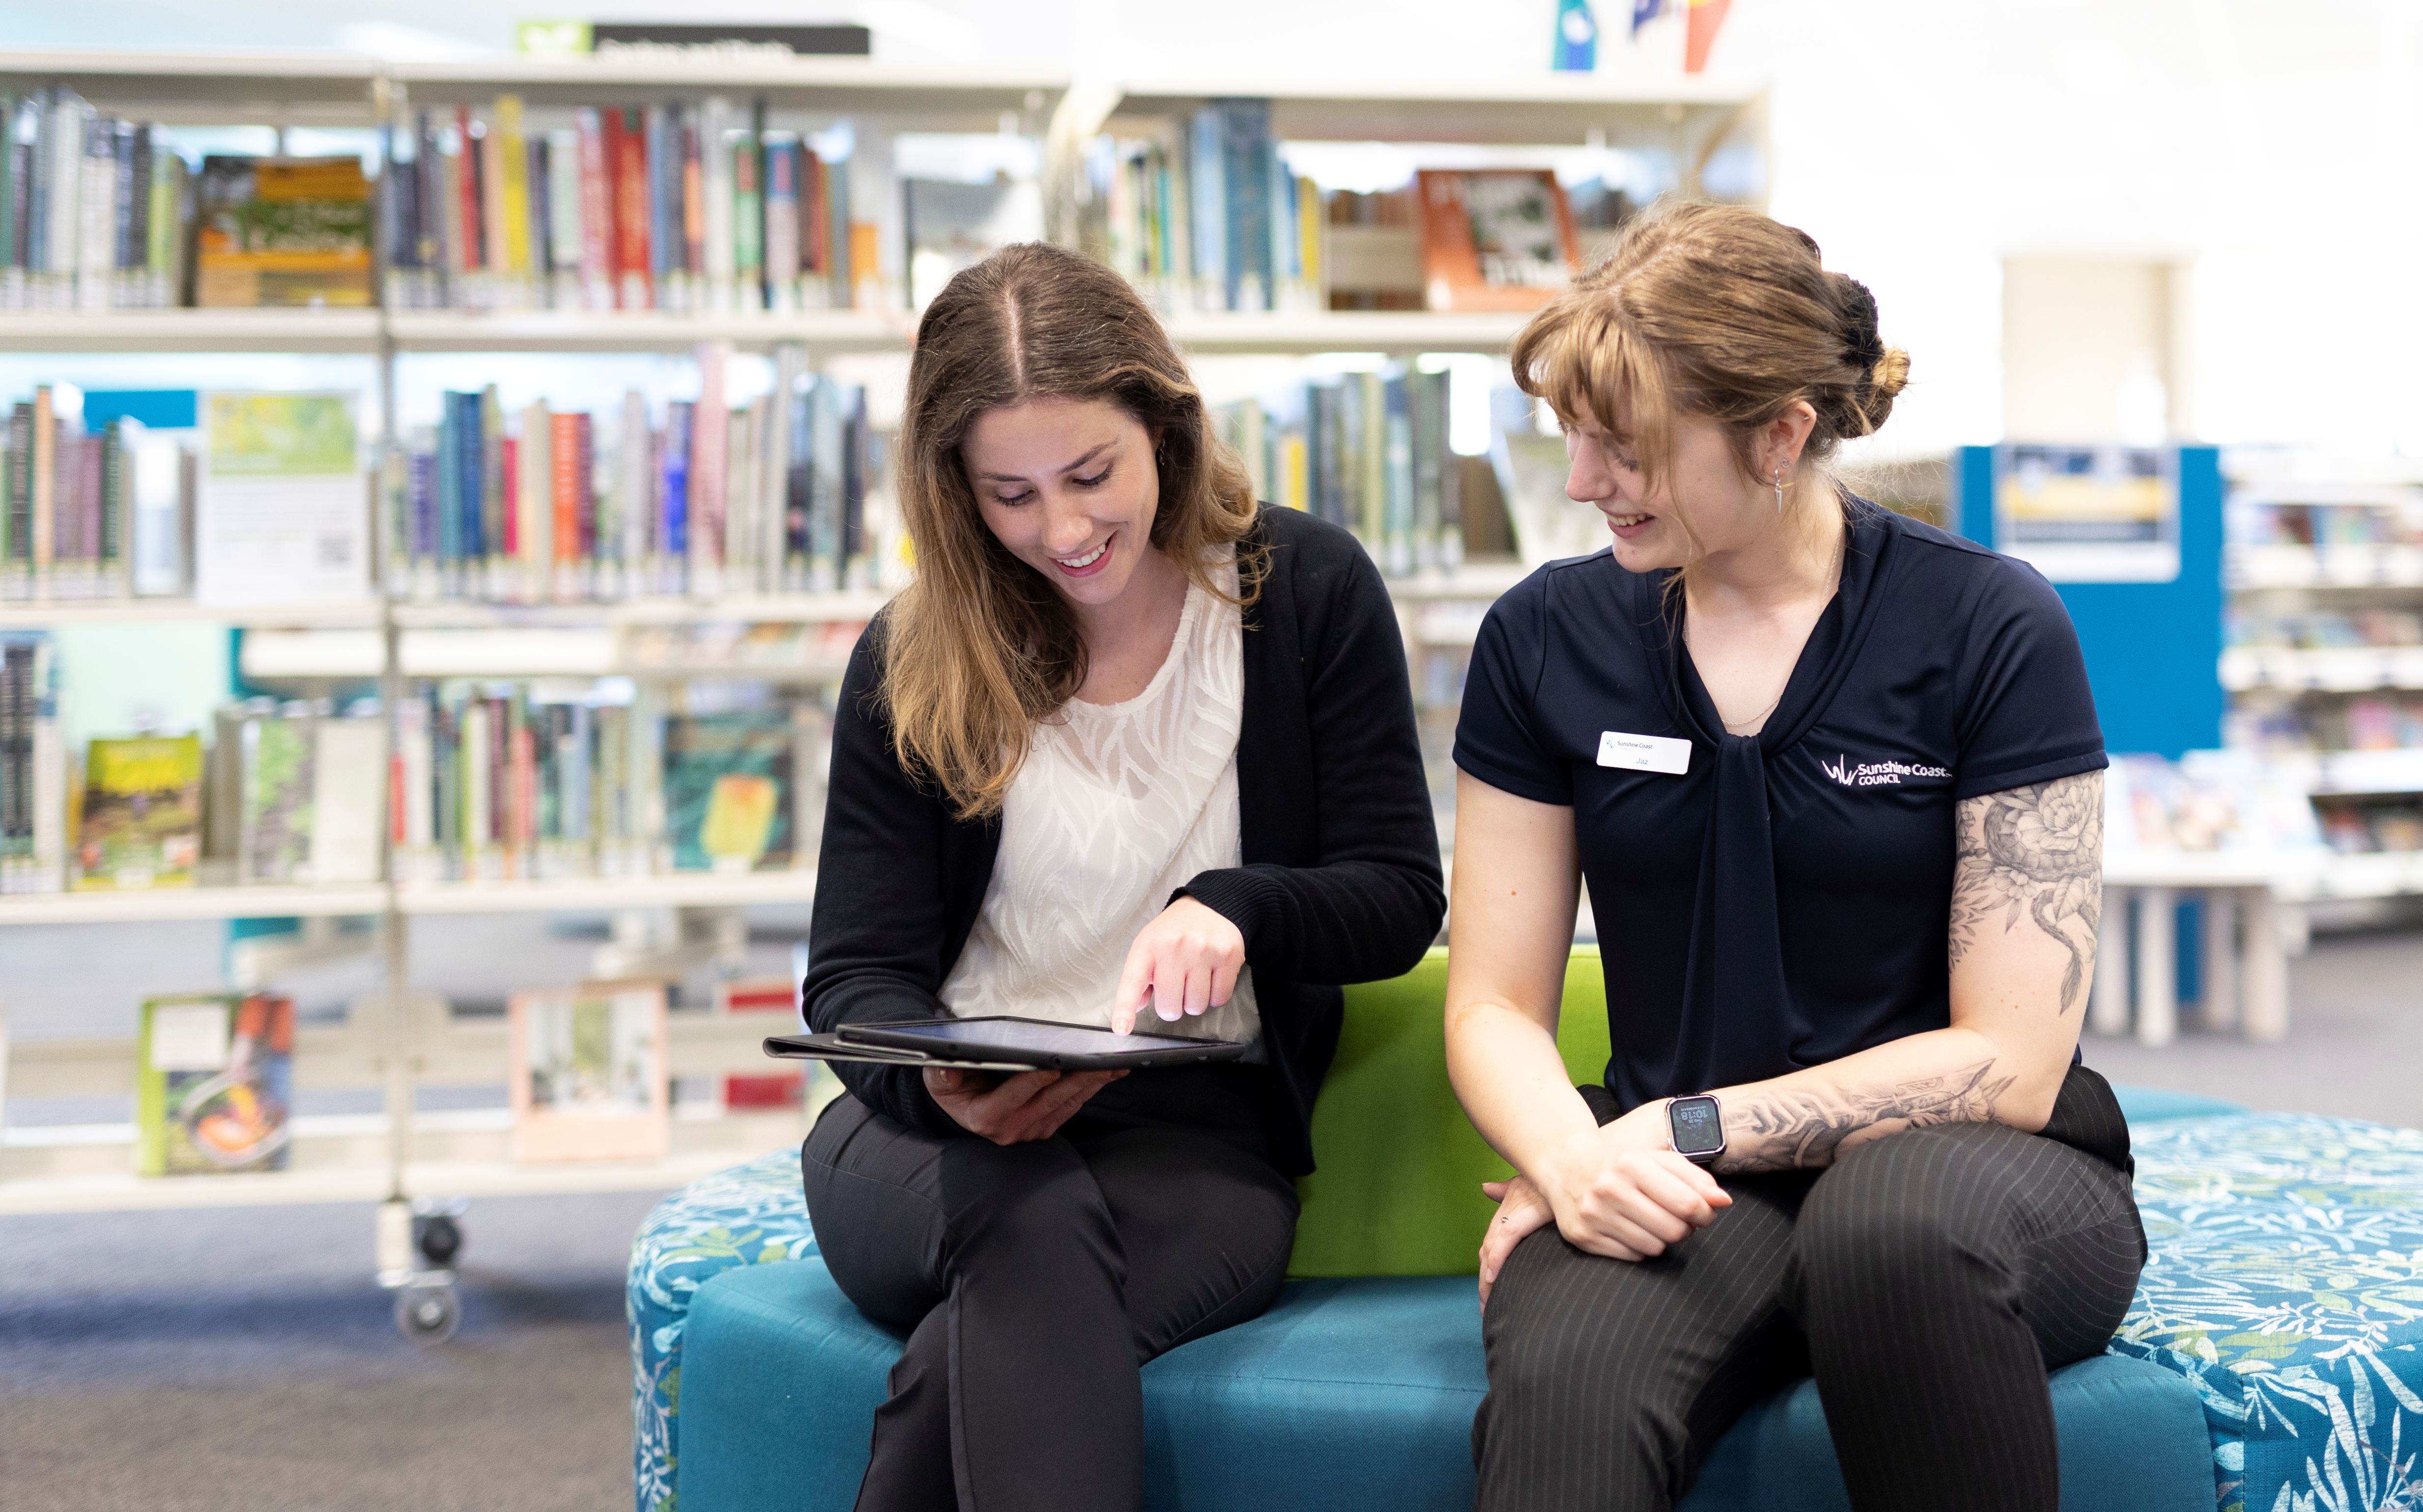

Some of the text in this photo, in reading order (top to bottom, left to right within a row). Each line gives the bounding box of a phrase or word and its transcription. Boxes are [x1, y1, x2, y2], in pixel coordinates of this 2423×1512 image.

[1858, 760, 1946, 777] Sunshine Coast
[1858, 774, 1900, 785] COUNCIL
[1681, 1110, 1708, 1120] 10:18
